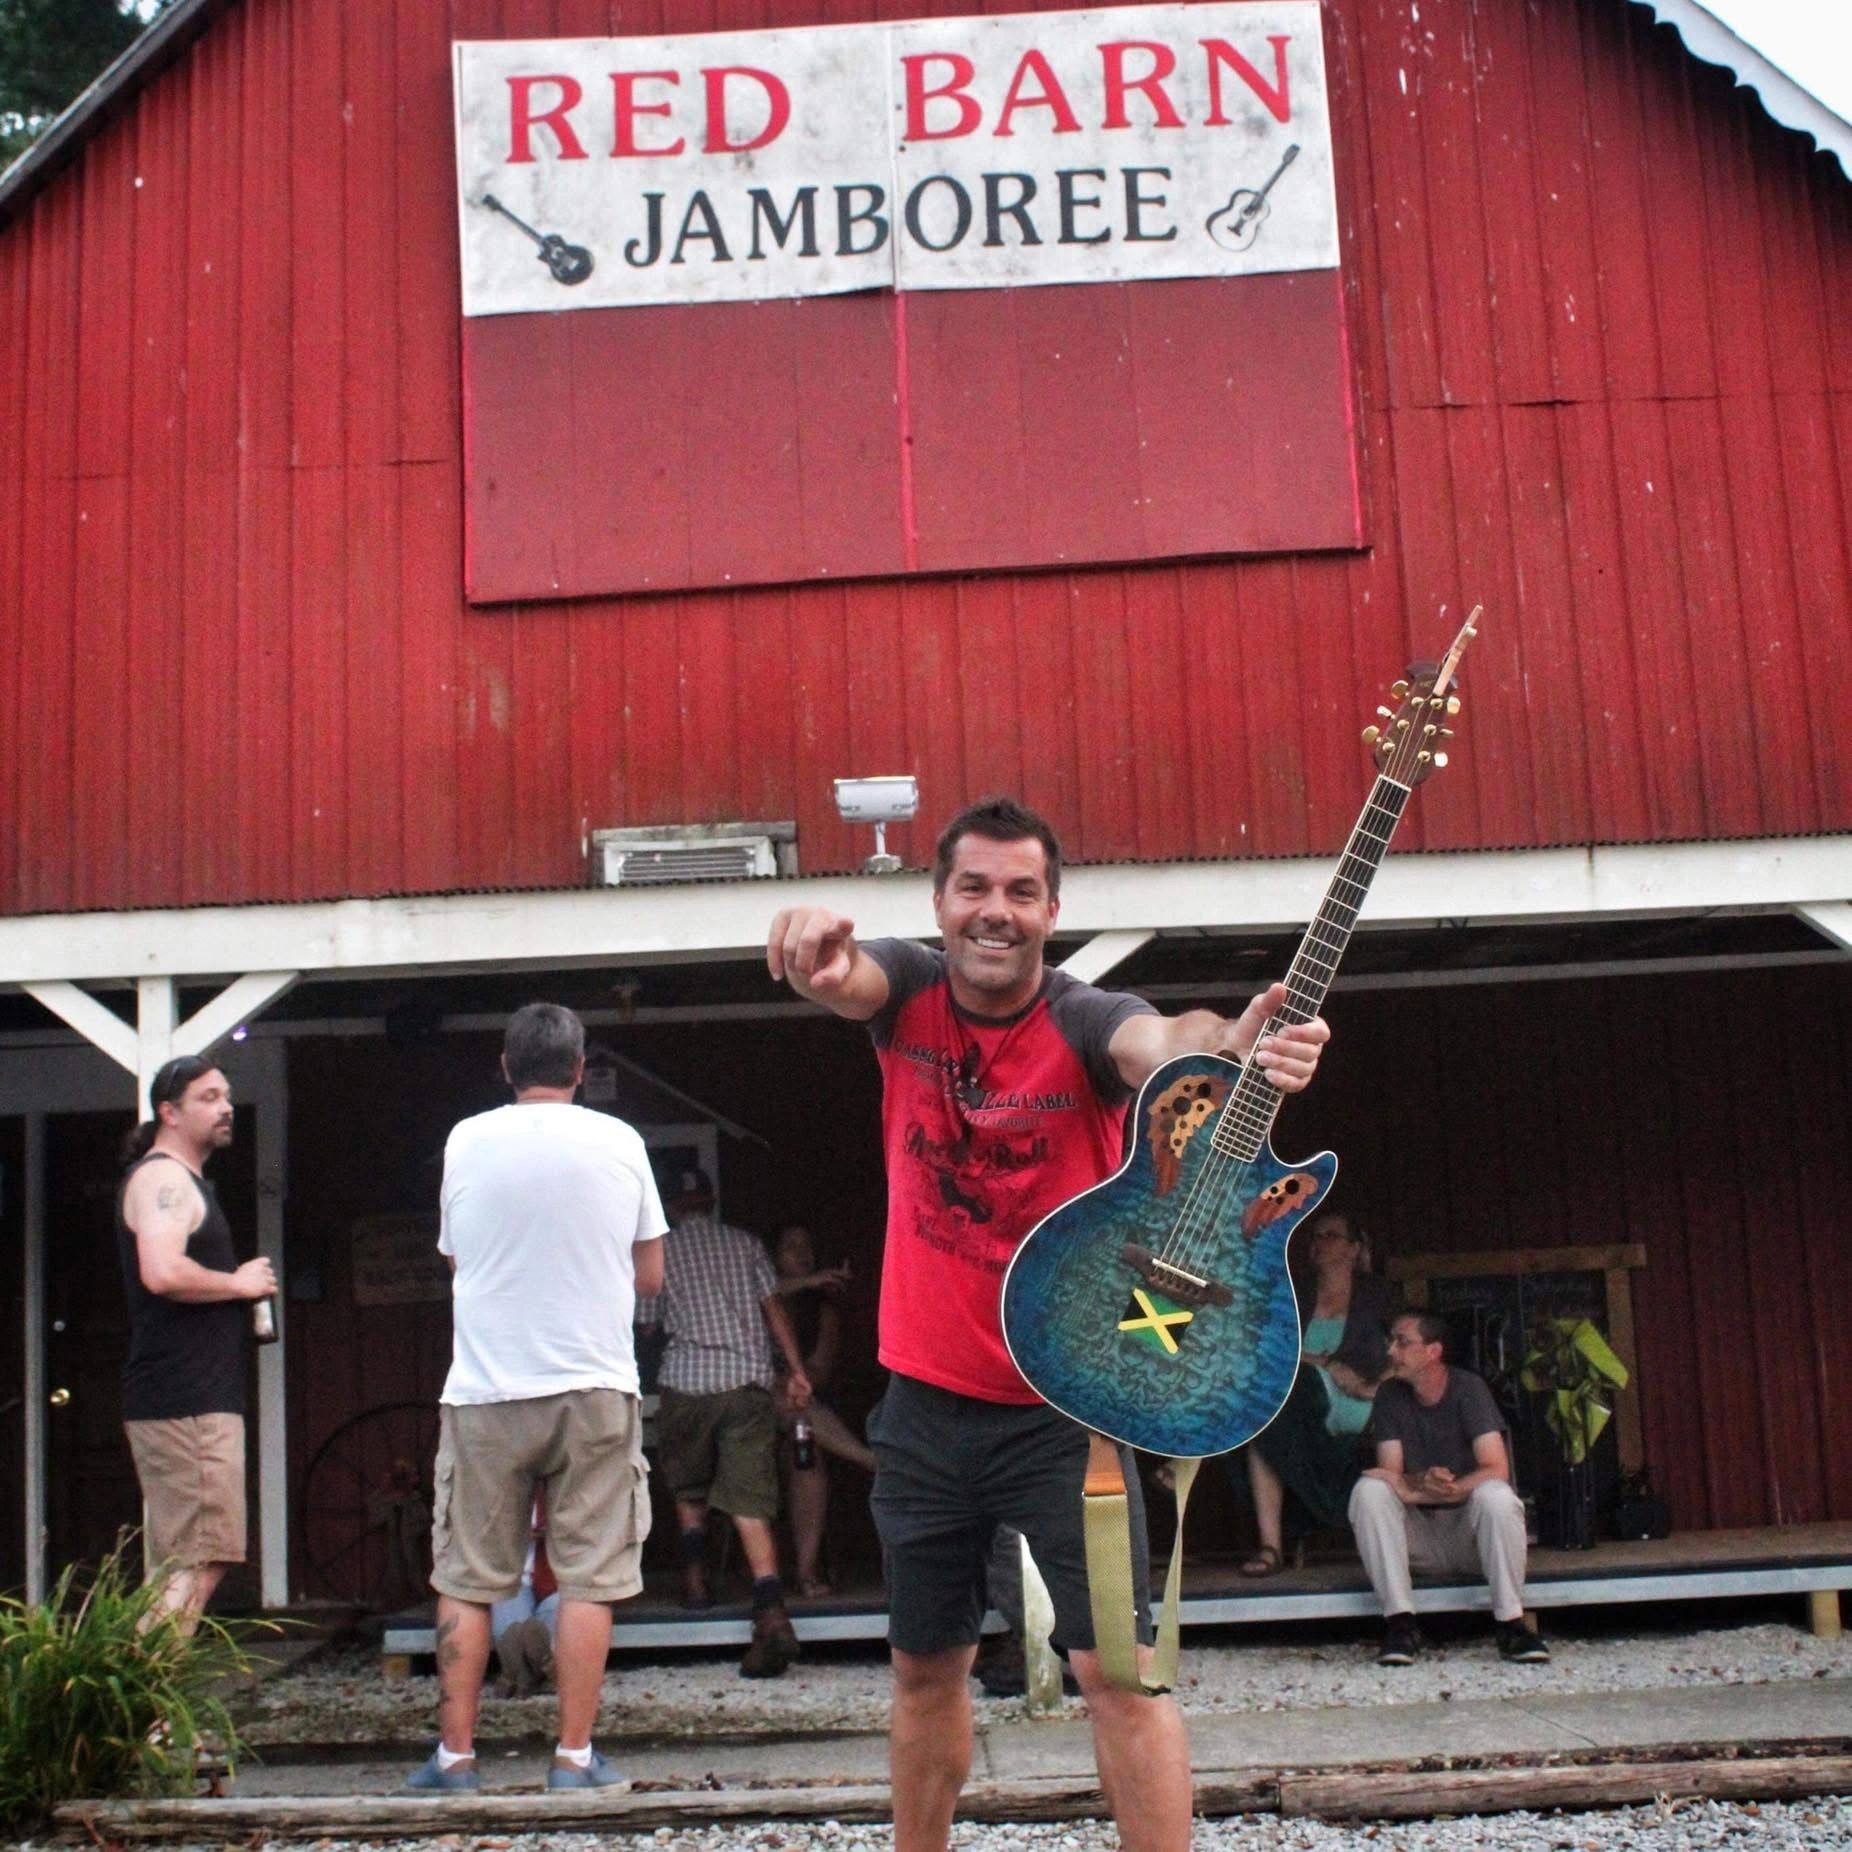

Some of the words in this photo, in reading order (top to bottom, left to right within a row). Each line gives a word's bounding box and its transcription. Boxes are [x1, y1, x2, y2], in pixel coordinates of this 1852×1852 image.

[506, 66, 791, 164] RED
[902, 35, 1291, 142] BARN
[623, 168, 1177, 268] JAMBOREE
[1023, 1091, 1076, 1110] LABEL
